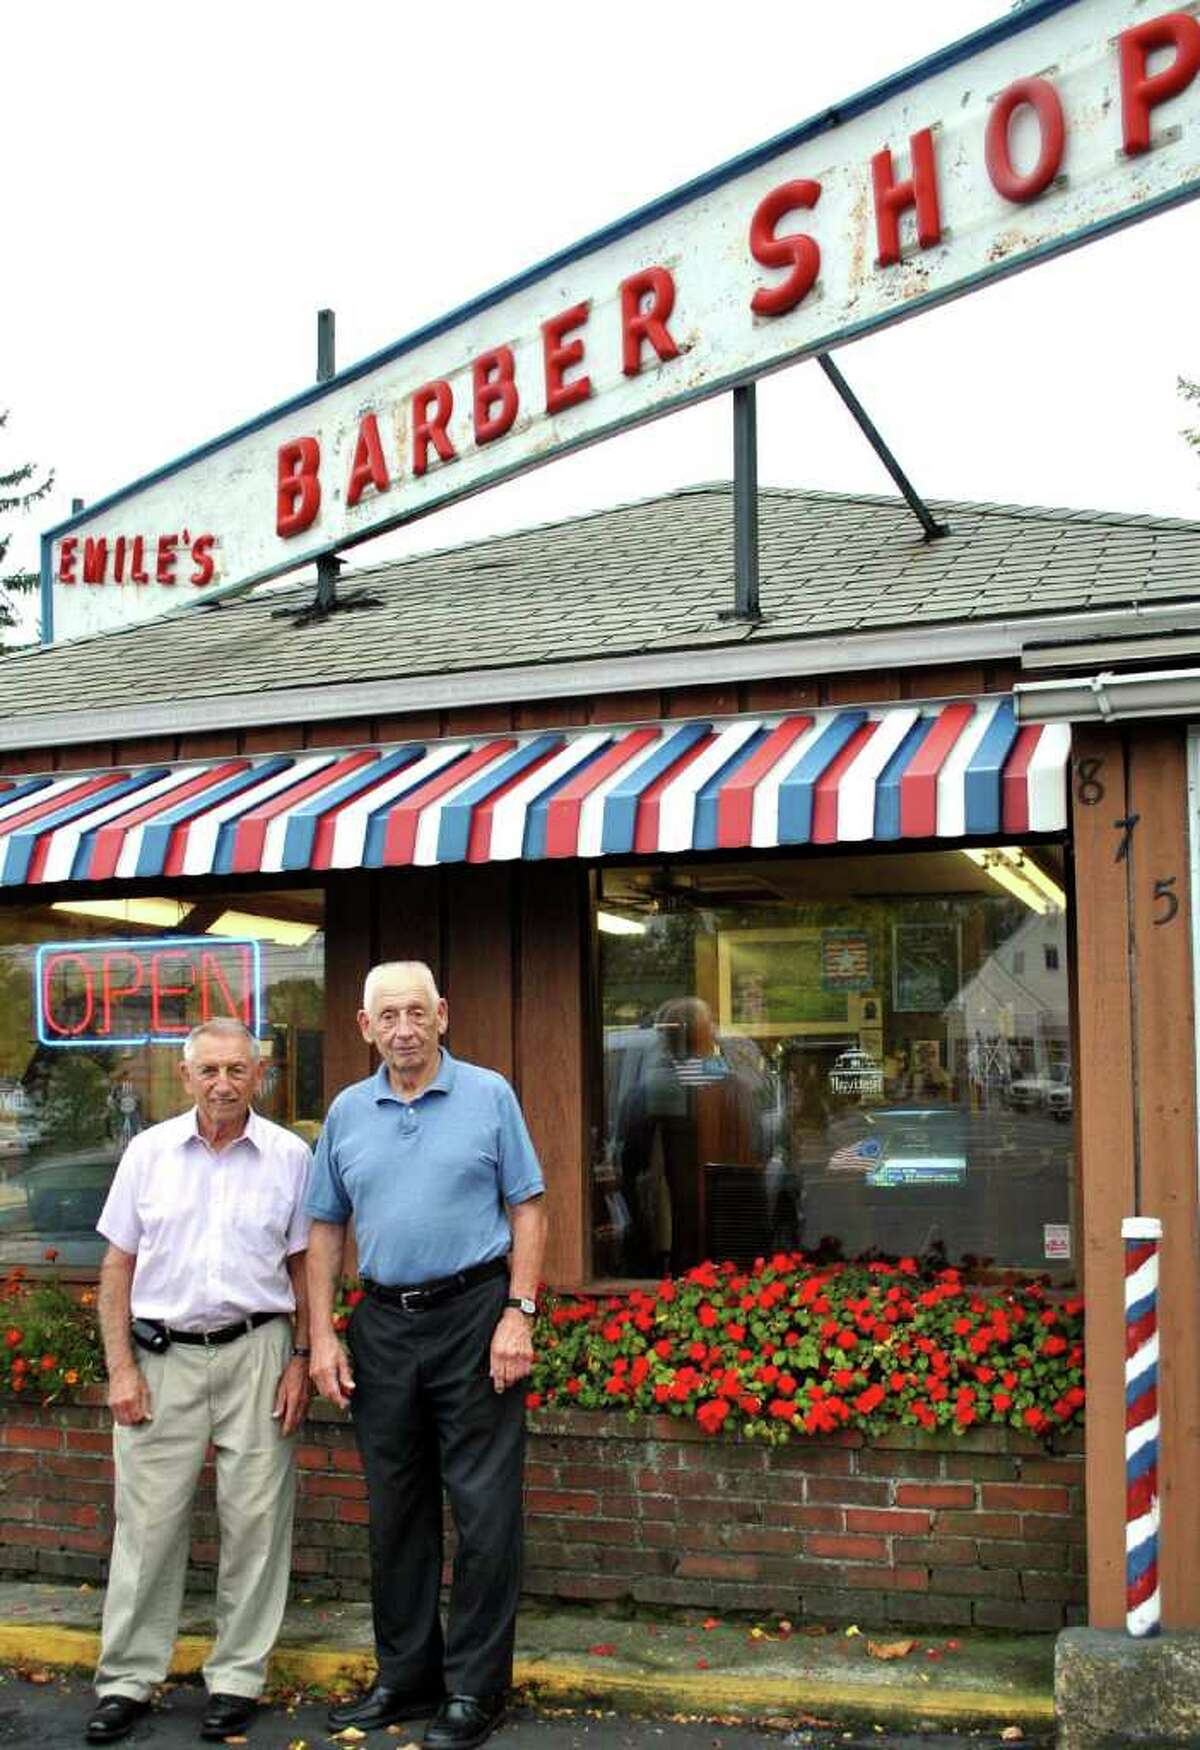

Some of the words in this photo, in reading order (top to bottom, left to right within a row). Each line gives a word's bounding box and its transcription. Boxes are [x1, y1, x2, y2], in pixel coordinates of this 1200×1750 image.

[60, 528, 215, 586] EMILE'S
[276, 265, 681, 539] BARBER
[749, 12, 1200, 317] SHOP
[43, 943, 252, 1035] OPEN
